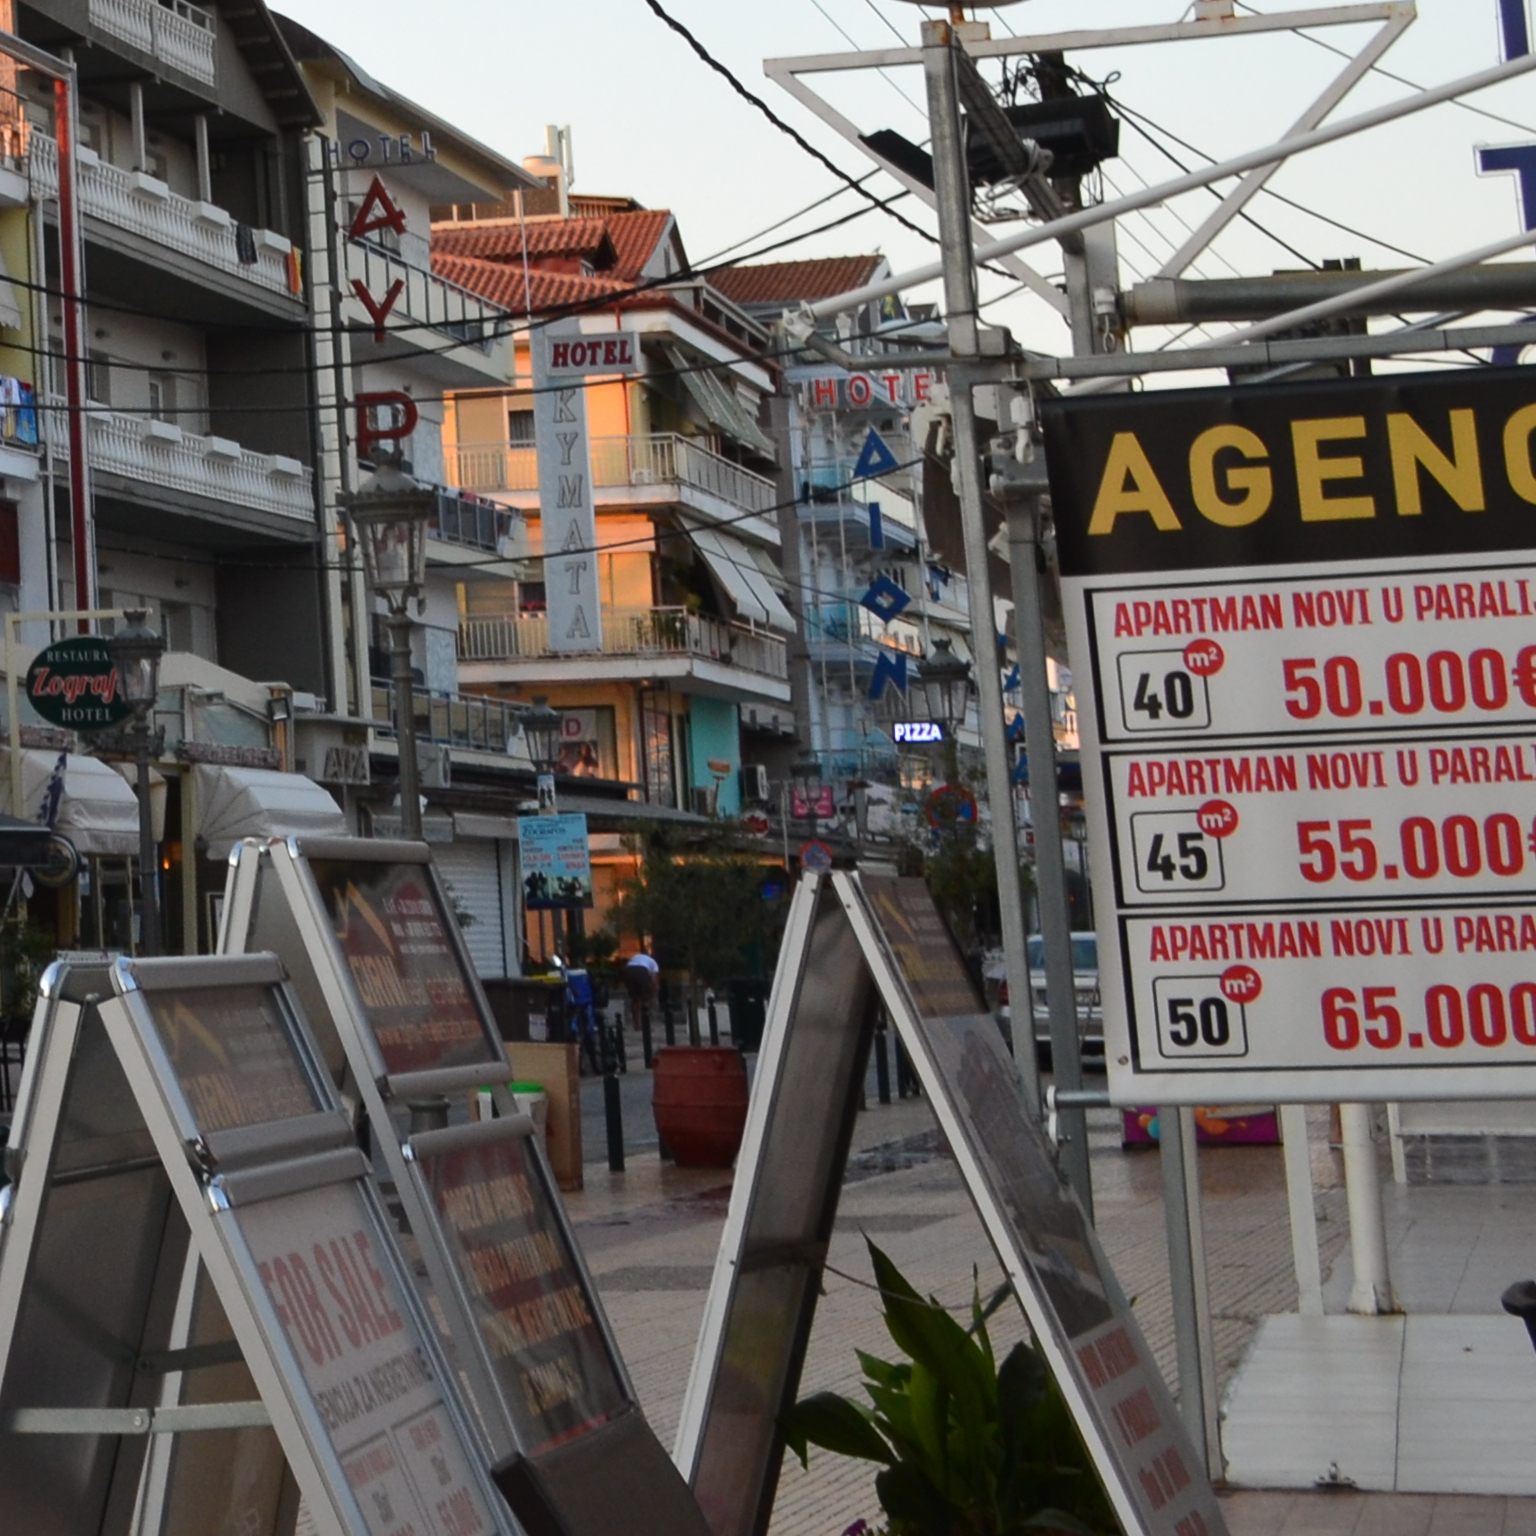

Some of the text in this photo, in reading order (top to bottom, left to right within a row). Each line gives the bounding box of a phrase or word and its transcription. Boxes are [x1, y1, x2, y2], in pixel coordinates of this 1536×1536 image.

[551, 340, 633, 370] HOTEL
[813, 371, 932, 406] HOTE
[1113, 578, 1536, 639] APARTMAN NOVI U PARALI
[46, 650, 110, 663] RESTAURA
[33, 666, 119, 704] Zograf
[1132, 671, 1195, 721] 40
[61, 707, 113, 722] HOTEL
[893, 722, 943, 743] PIZZA
[1127, 755, 1299, 799] APARTMAN
[1308, 749, 1387, 791] NOVI
[1396, 747, 1419, 784] U
[1146, 831, 1209, 882] 45
[1297, 812, 1536, 885] 55.000
[1150, 918, 1322, 963] APARTMAN
[1330, 914, 1412, 957] NOVI
[1421, 913, 1445, 951] U
[1167, 995, 1232, 1048] 50
[259, 1251, 344, 1367] FOR
[312, 1229, 404, 1350] SALE
